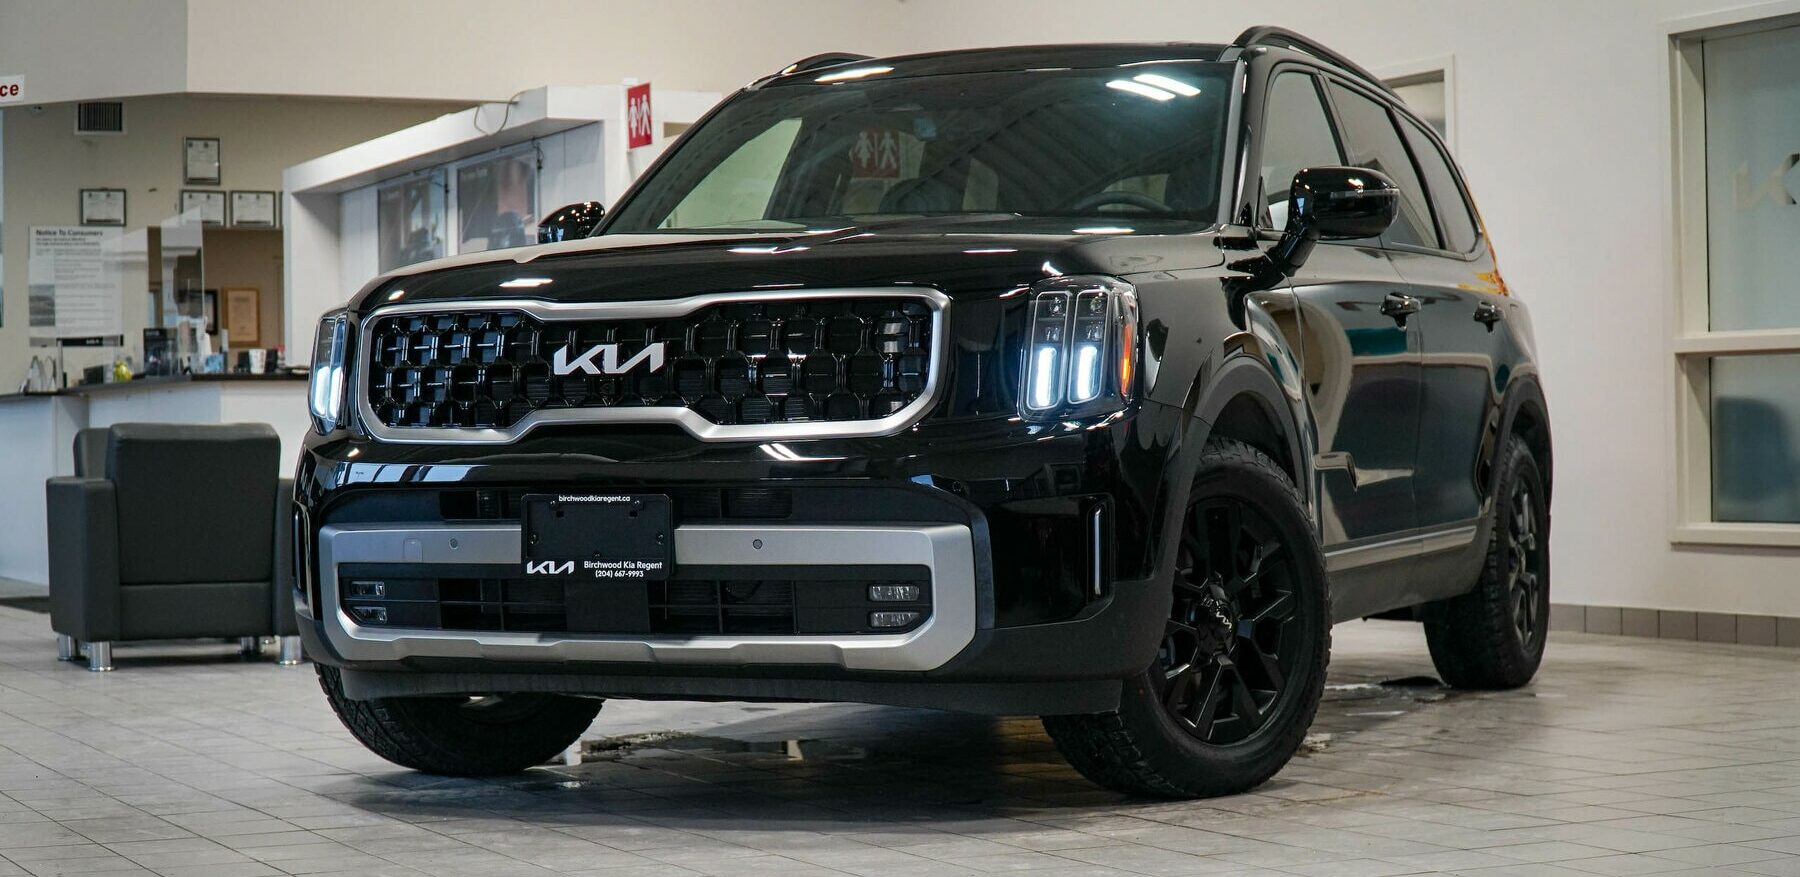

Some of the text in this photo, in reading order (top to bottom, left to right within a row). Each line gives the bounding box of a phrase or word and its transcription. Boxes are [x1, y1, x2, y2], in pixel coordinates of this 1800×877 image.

[553, 342, 665, 375] KIA
[558, 495, 631, 503] birchwoodkiaregent.ca
[526, 560, 575, 575] KIA
[583, 561, 663, 571] Birchwood Kia Regent
[595, 570, 644, 578] (204) 667-9993
